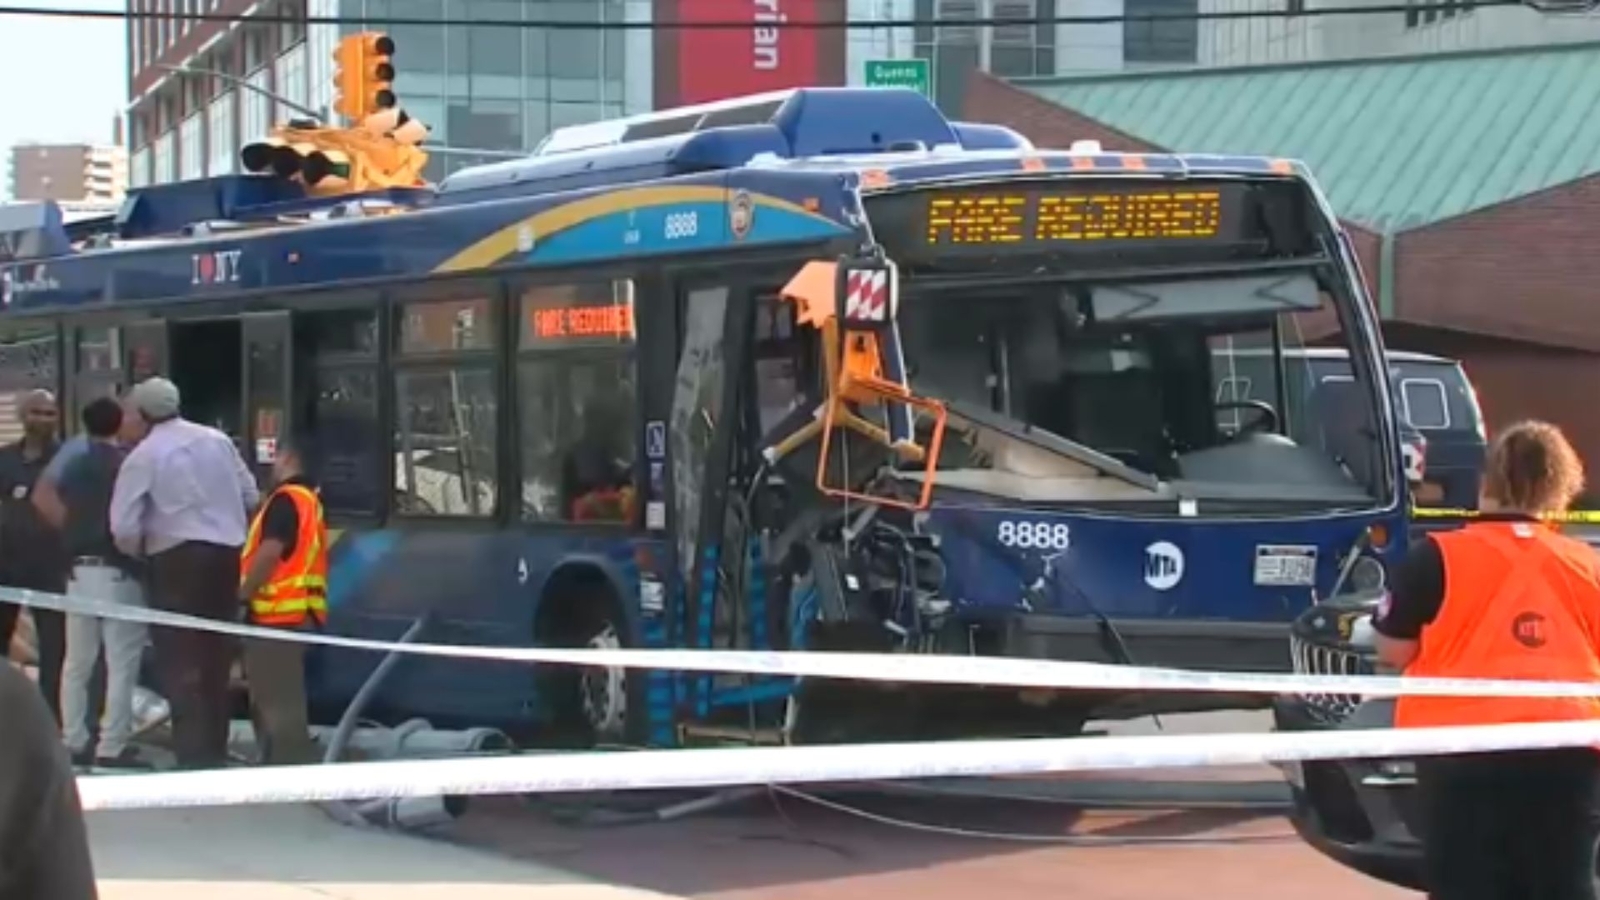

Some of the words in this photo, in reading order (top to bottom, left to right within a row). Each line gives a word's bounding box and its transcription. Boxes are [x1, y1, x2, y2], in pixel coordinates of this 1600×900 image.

[755, 0, 787, 69] rian
[664, 210, 698, 239] 8888
[927, 196, 1025, 242] FARE
[1035, 192, 1220, 240] REQUIRED
[998, 520, 1069, 549] 8888
